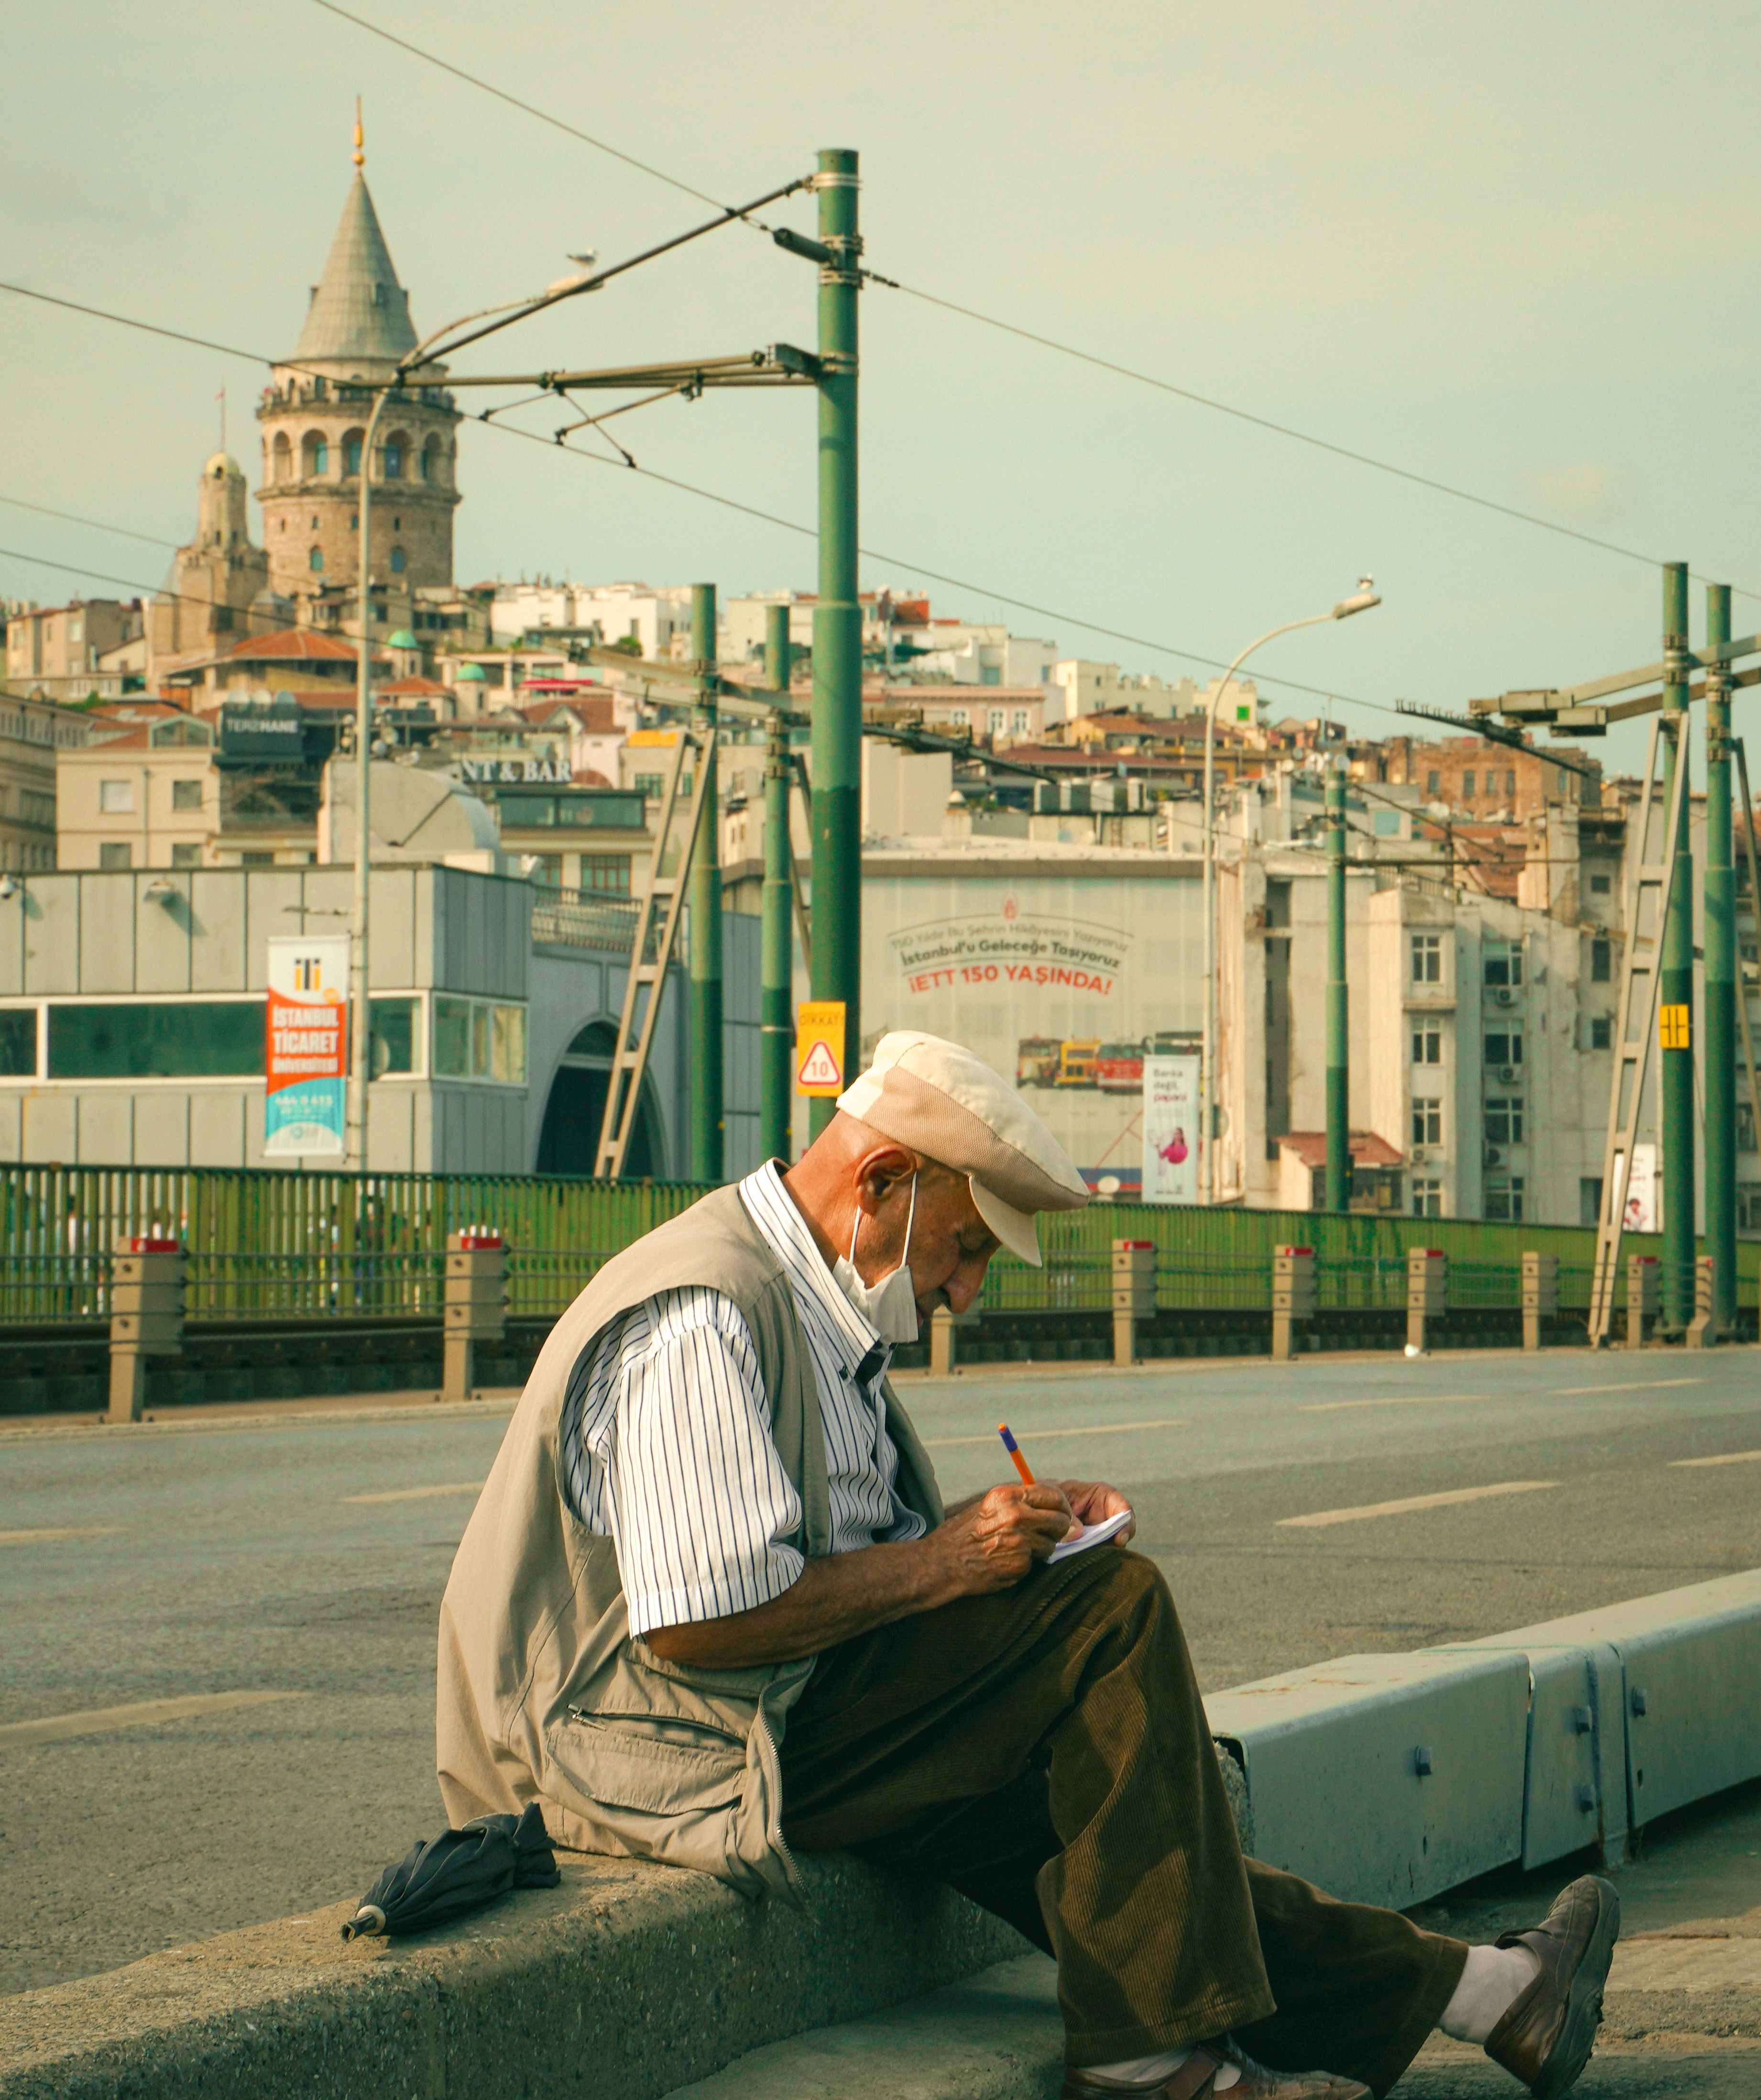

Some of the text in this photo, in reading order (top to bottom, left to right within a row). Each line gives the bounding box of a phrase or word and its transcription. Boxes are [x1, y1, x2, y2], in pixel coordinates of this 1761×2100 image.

[499, 761, 518, 782] &
[523, 760, 571, 782] BAR
[979, 939, 1049, 955] Geleceğe
[1051, 941, 1121, 969] Taşıyoruz
[961, 965, 999, 984] 150
[1004, 964, 1113, 996] YAŞINDA!
[273, 1005, 339, 1028] İSTANBUL
[273, 1028, 339, 1054] TİCARET
[811, 1061, 828, 1077] 10
